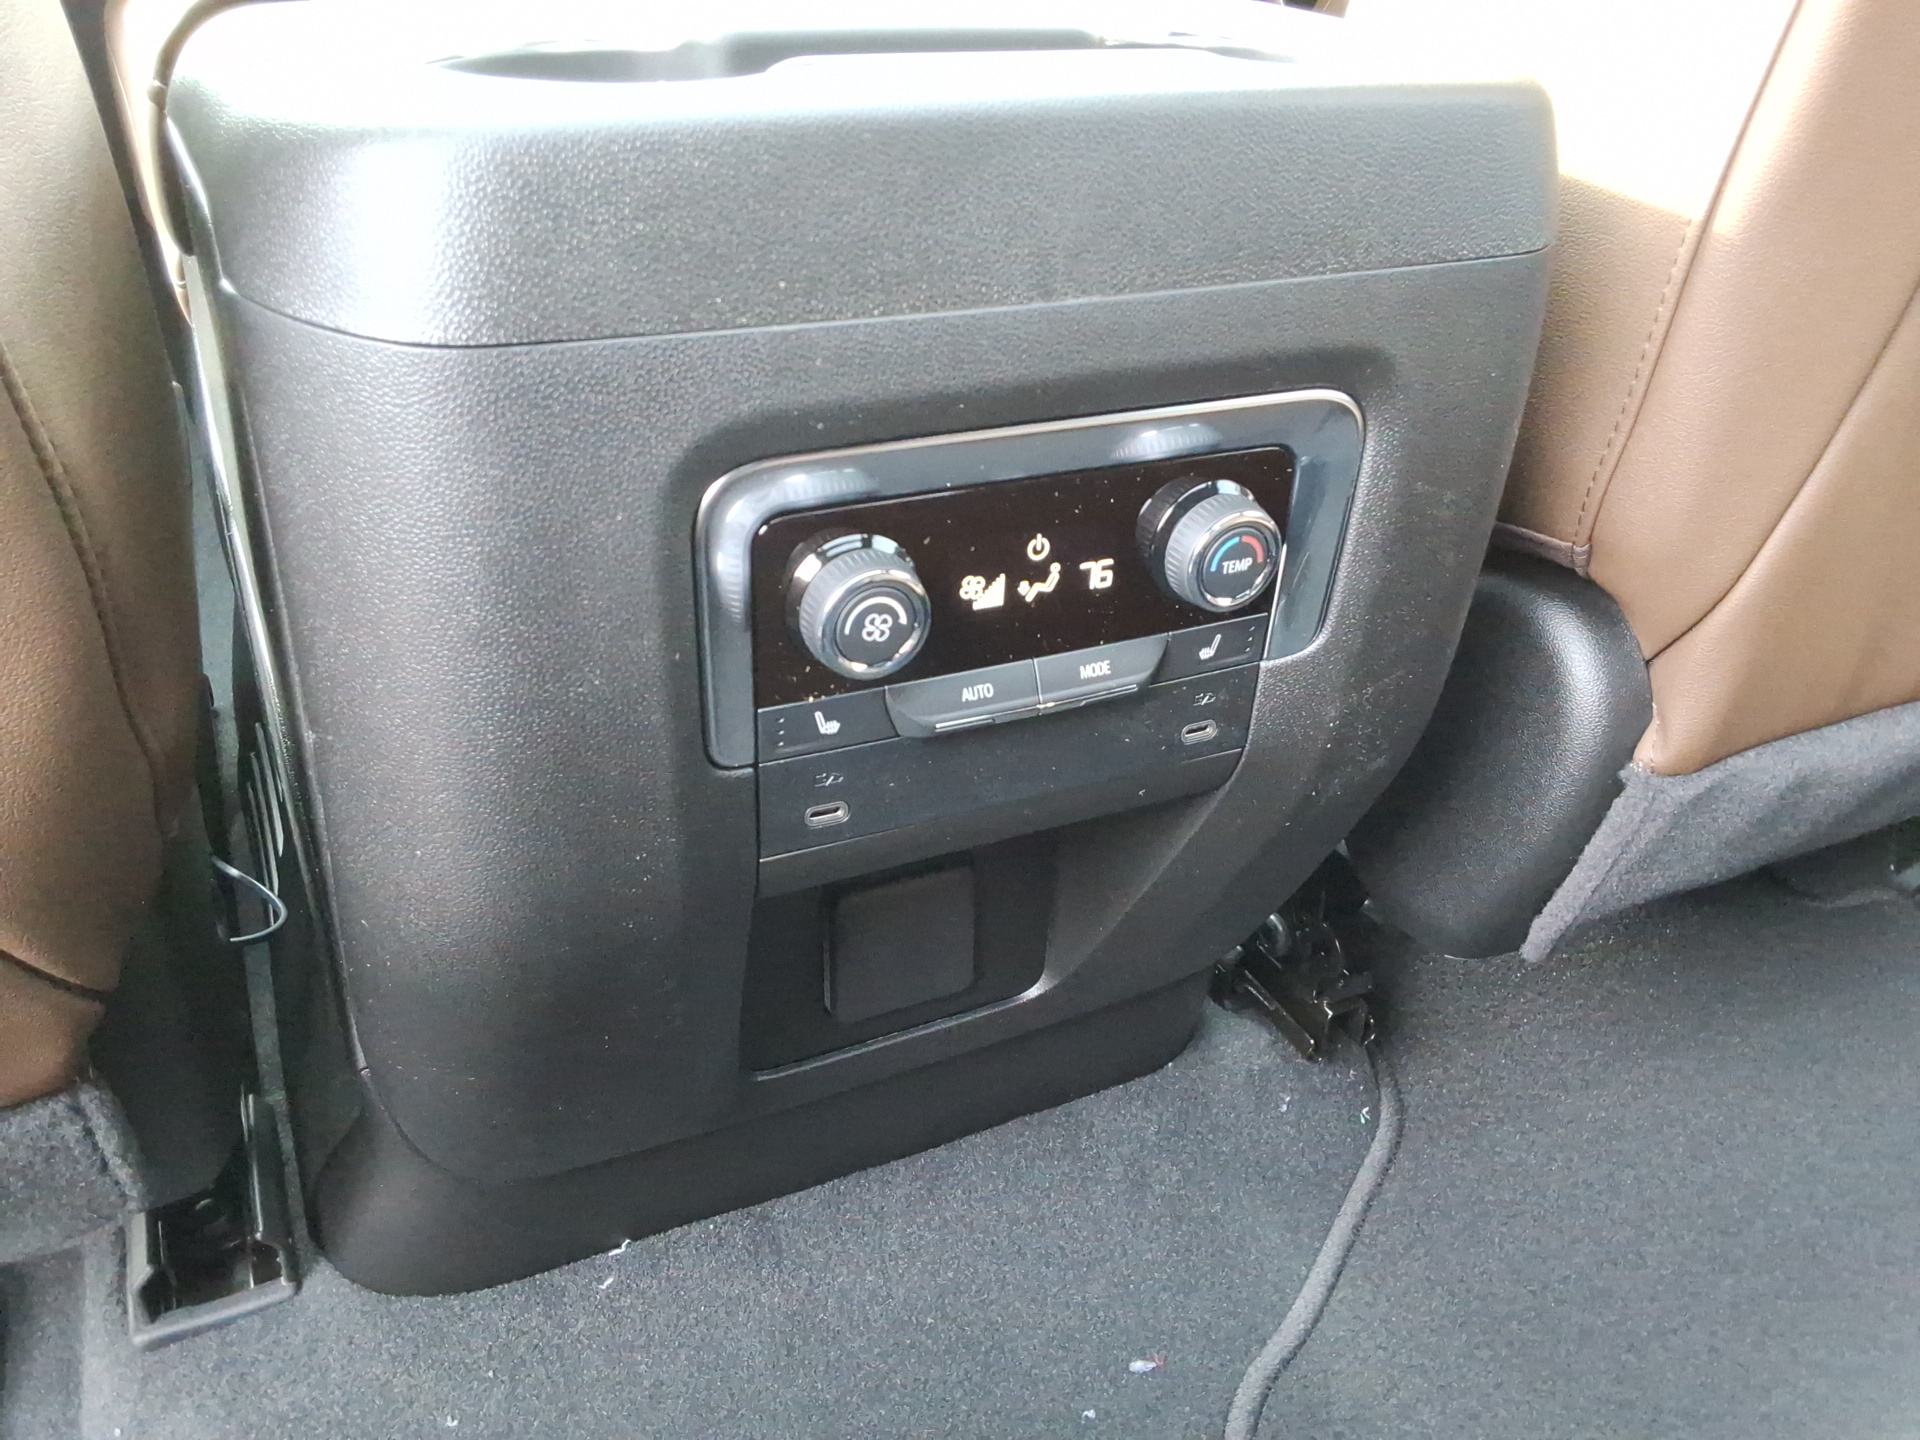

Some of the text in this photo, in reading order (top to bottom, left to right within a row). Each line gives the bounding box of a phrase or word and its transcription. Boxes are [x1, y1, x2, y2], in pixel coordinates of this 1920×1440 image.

[1079, 558, 1114, 590] 76
[1222, 557, 1253, 575] TEMP
[1080, 660, 1112, 680] MODE
[962, 683, 994, 702] AUTO
